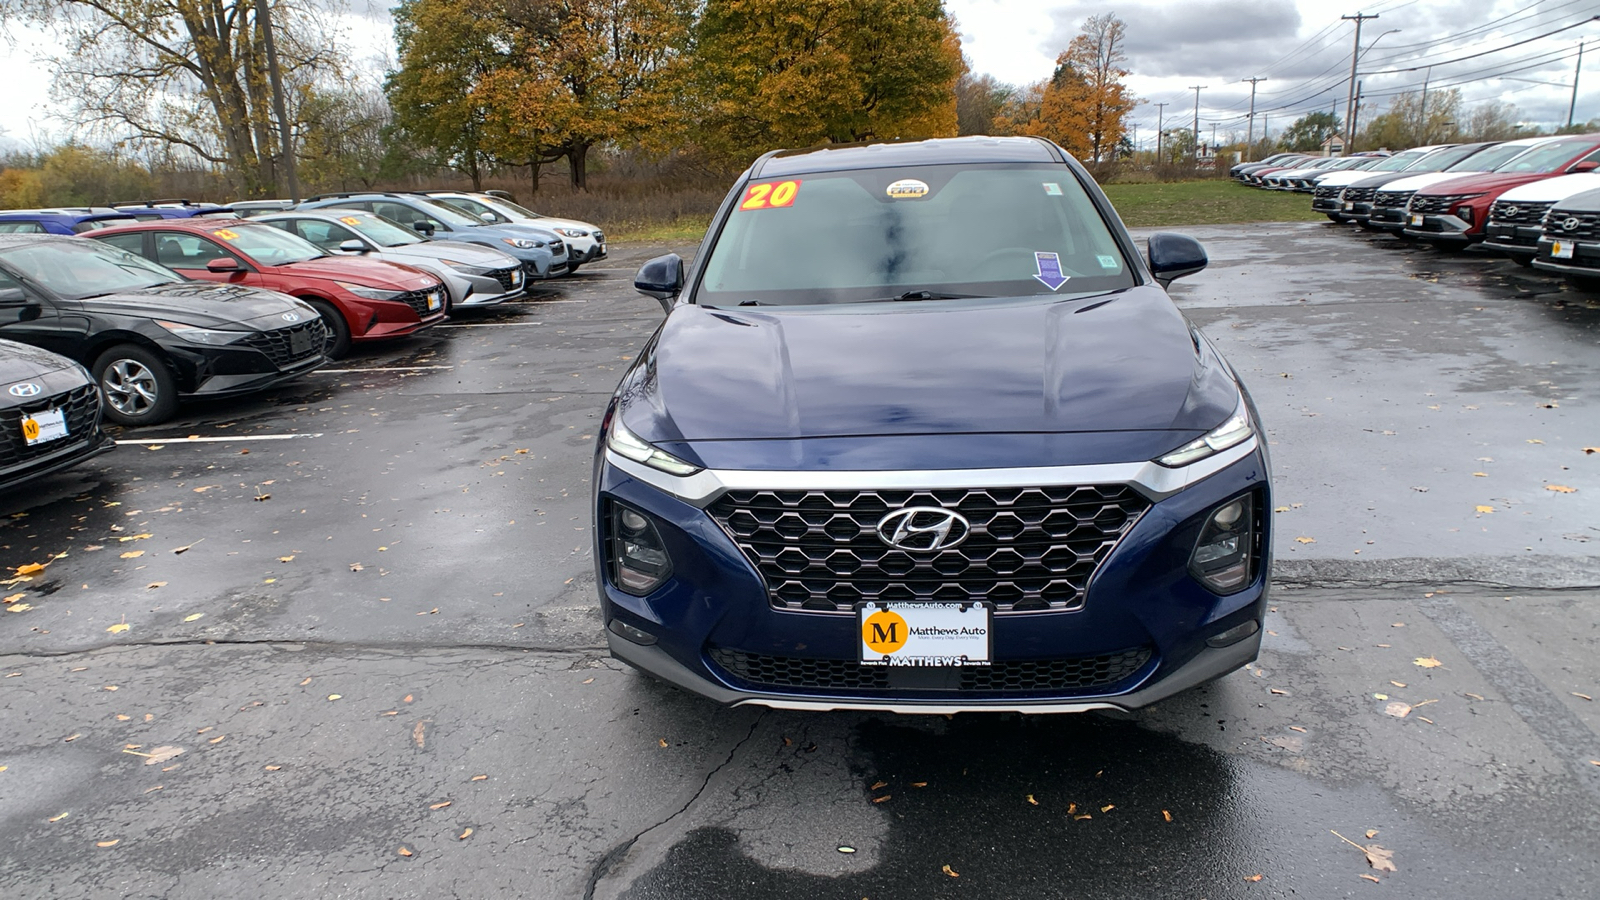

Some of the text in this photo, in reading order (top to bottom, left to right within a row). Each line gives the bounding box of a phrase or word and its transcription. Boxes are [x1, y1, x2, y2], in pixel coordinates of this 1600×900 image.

[742, 181, 797, 209] 20
[25, 423, 36, 436] M
[886, 601, 963, 609] MatthewsAuto.com
[870, 622, 899, 644] M
[909, 626, 987, 636] Matthews Auto
[889, 656, 962, 667] MATTHEWS
